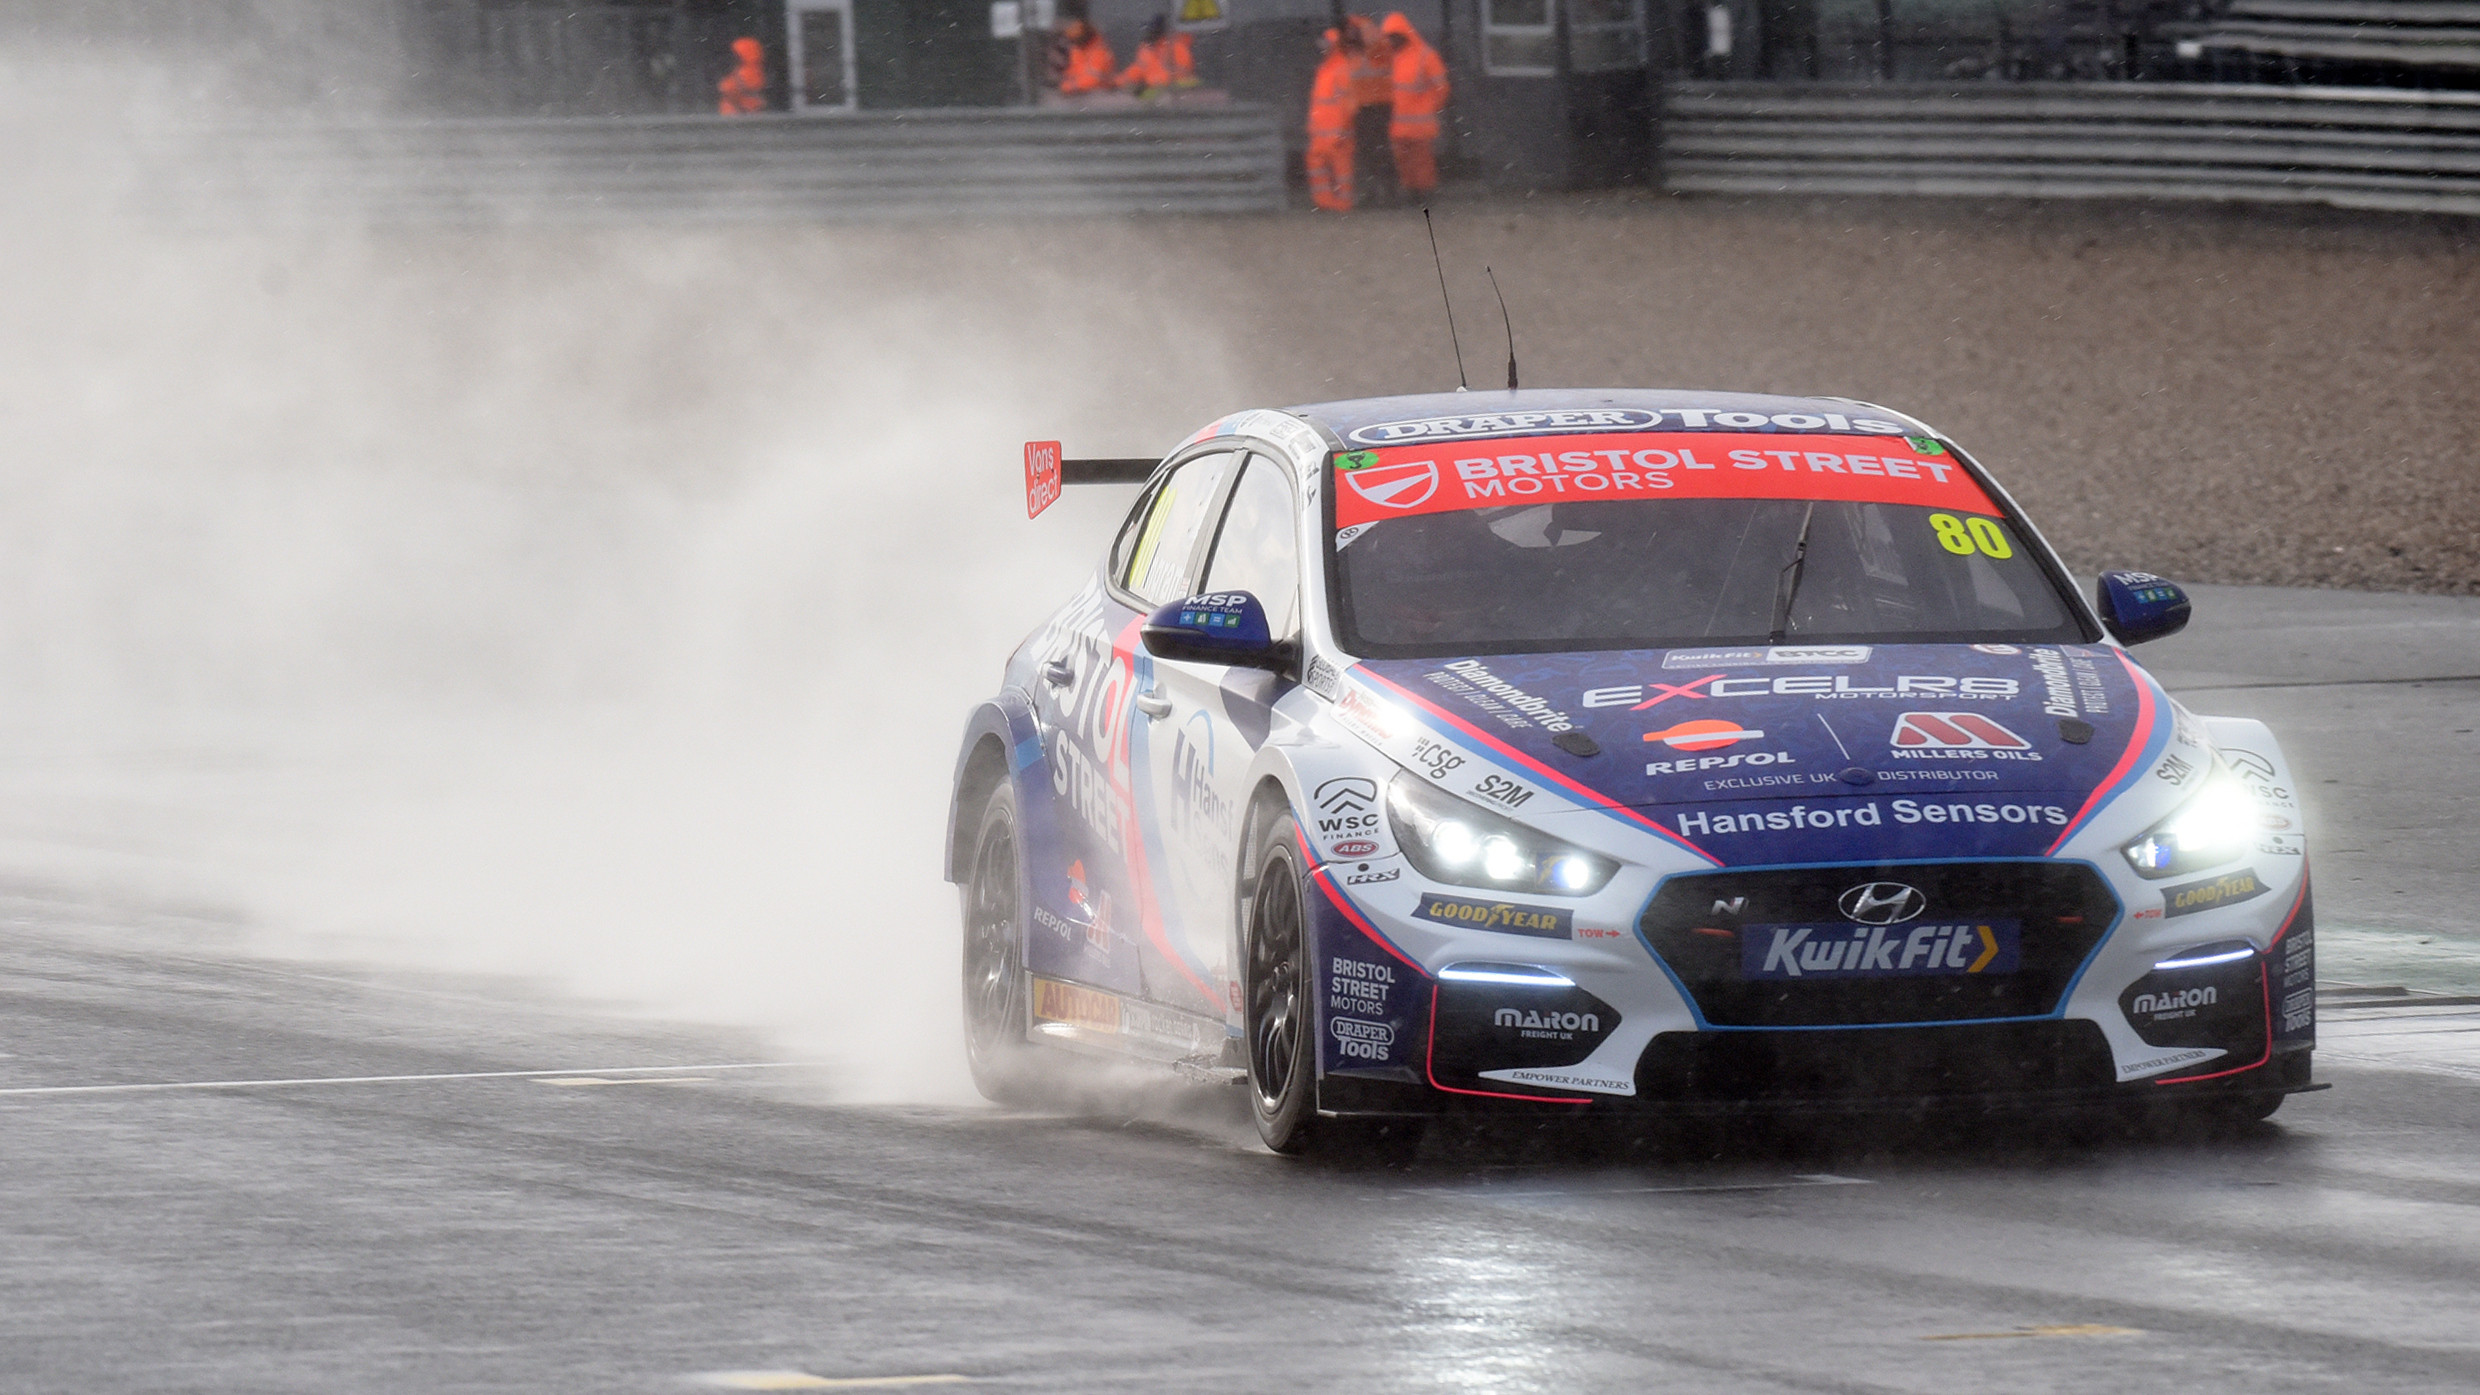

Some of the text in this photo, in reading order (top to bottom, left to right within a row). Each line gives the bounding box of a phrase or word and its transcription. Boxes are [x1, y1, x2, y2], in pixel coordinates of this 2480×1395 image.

[1383, 408, 1904, 440] DRAPER Tools
[1027, 443, 1054, 476] Vans
[1453, 448, 1952, 484] BRISTOL STREET
[1464, 471, 1675, 499] MOTORS
[1928, 513, 2013, 560] 80
[1184, 594, 1248, 607] MSP
[1219, 606, 1243, 614] TEAM
[1582, 673, 2020, 711] EXCELR8
[2028, 647, 2079, 718] Diamondbrite
[1444, 659, 1573, 732] Diamondbrite
[1815, 691, 2019, 701] MOTORSPORT
[1645, 749, 1796, 776] REPSOL
[1890, 749, 2043, 762] MILLERS OILS
[1474, 774, 1535, 808] S2M
[1703, 770, 2000, 791] EXCLUSIVE UK DISTRIBUTOR
[1052, 728, 1131, 865] STREET
[1318, 813, 1379, 833] WSC
[1676, 799, 2069, 837] Hansford Sensors
[1322, 827, 1379, 841] FINANCE
[1338, 843, 1373, 853] ABS
[1033, 906, 1073, 942] REPSOL
[1577, 928, 1604, 938] TOW
[1332, 957, 1396, 984] BRISTOL
[1331, 976, 1390, 1001] STREET
[1330, 994, 1384, 1016] MOTORS
[1336, 1020, 1389, 1042] DRAPER
[1494, 1007, 1599, 1032] MARON
[1520, 1029, 1574, 1040] FREIGHT UK
[1337, 1035, 1390, 1061] Tools
[1511, 1071, 1630, 1090] EMPOWER PARTNERS
